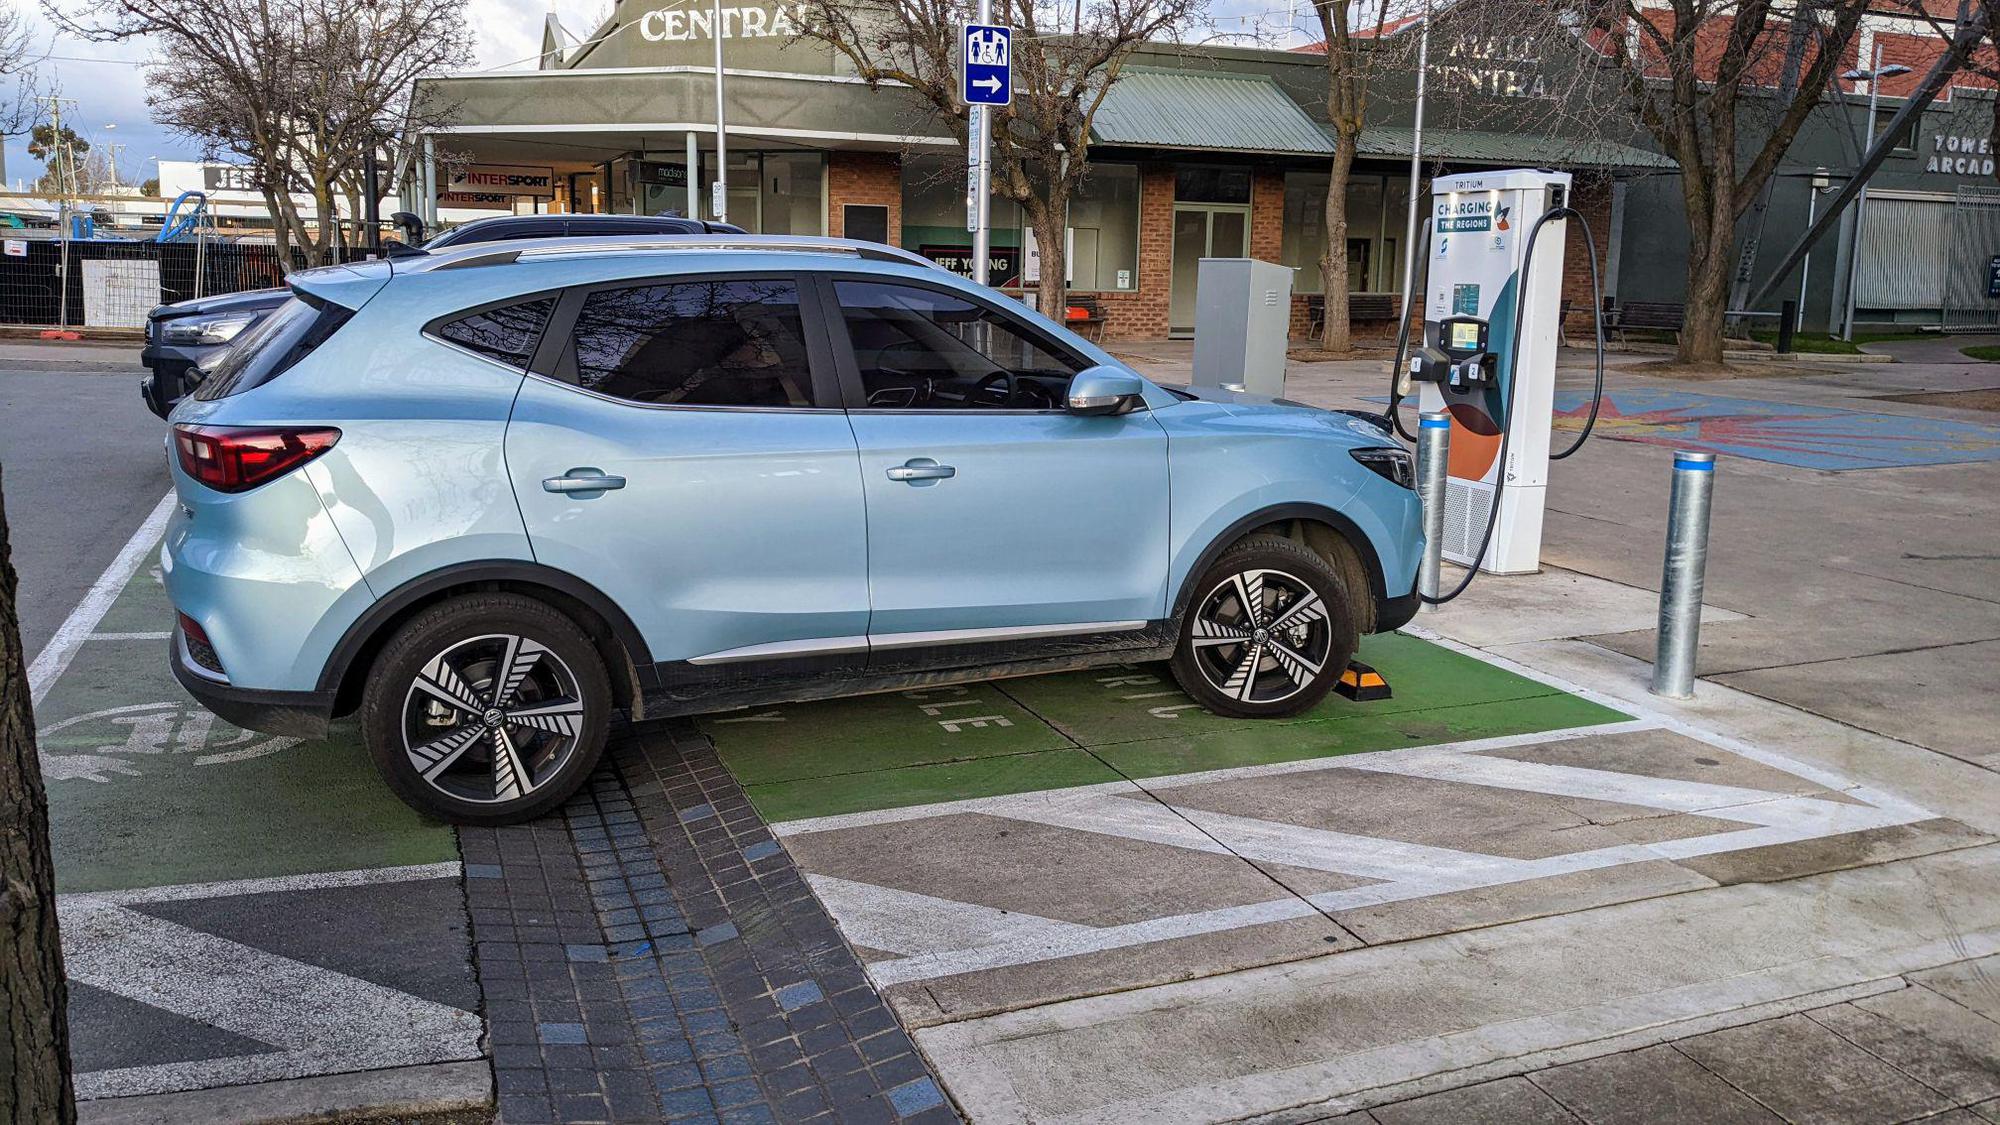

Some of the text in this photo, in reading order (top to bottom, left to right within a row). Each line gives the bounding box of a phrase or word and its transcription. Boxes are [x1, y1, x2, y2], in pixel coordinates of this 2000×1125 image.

[1935, 135, 1994, 154] TOWE
[1926, 156, 1994, 175] ARCAD
[467, 172, 549, 187] INTERSPORT
[1455, 180, 1483, 189] TRITIUM
[442, 192, 507, 203] INTERSPORT
[1438, 202, 1492, 215] CHARGING
[1441, 219, 1487, 229] THE REGIONS
[961, 258, 1008, 271] YONG
